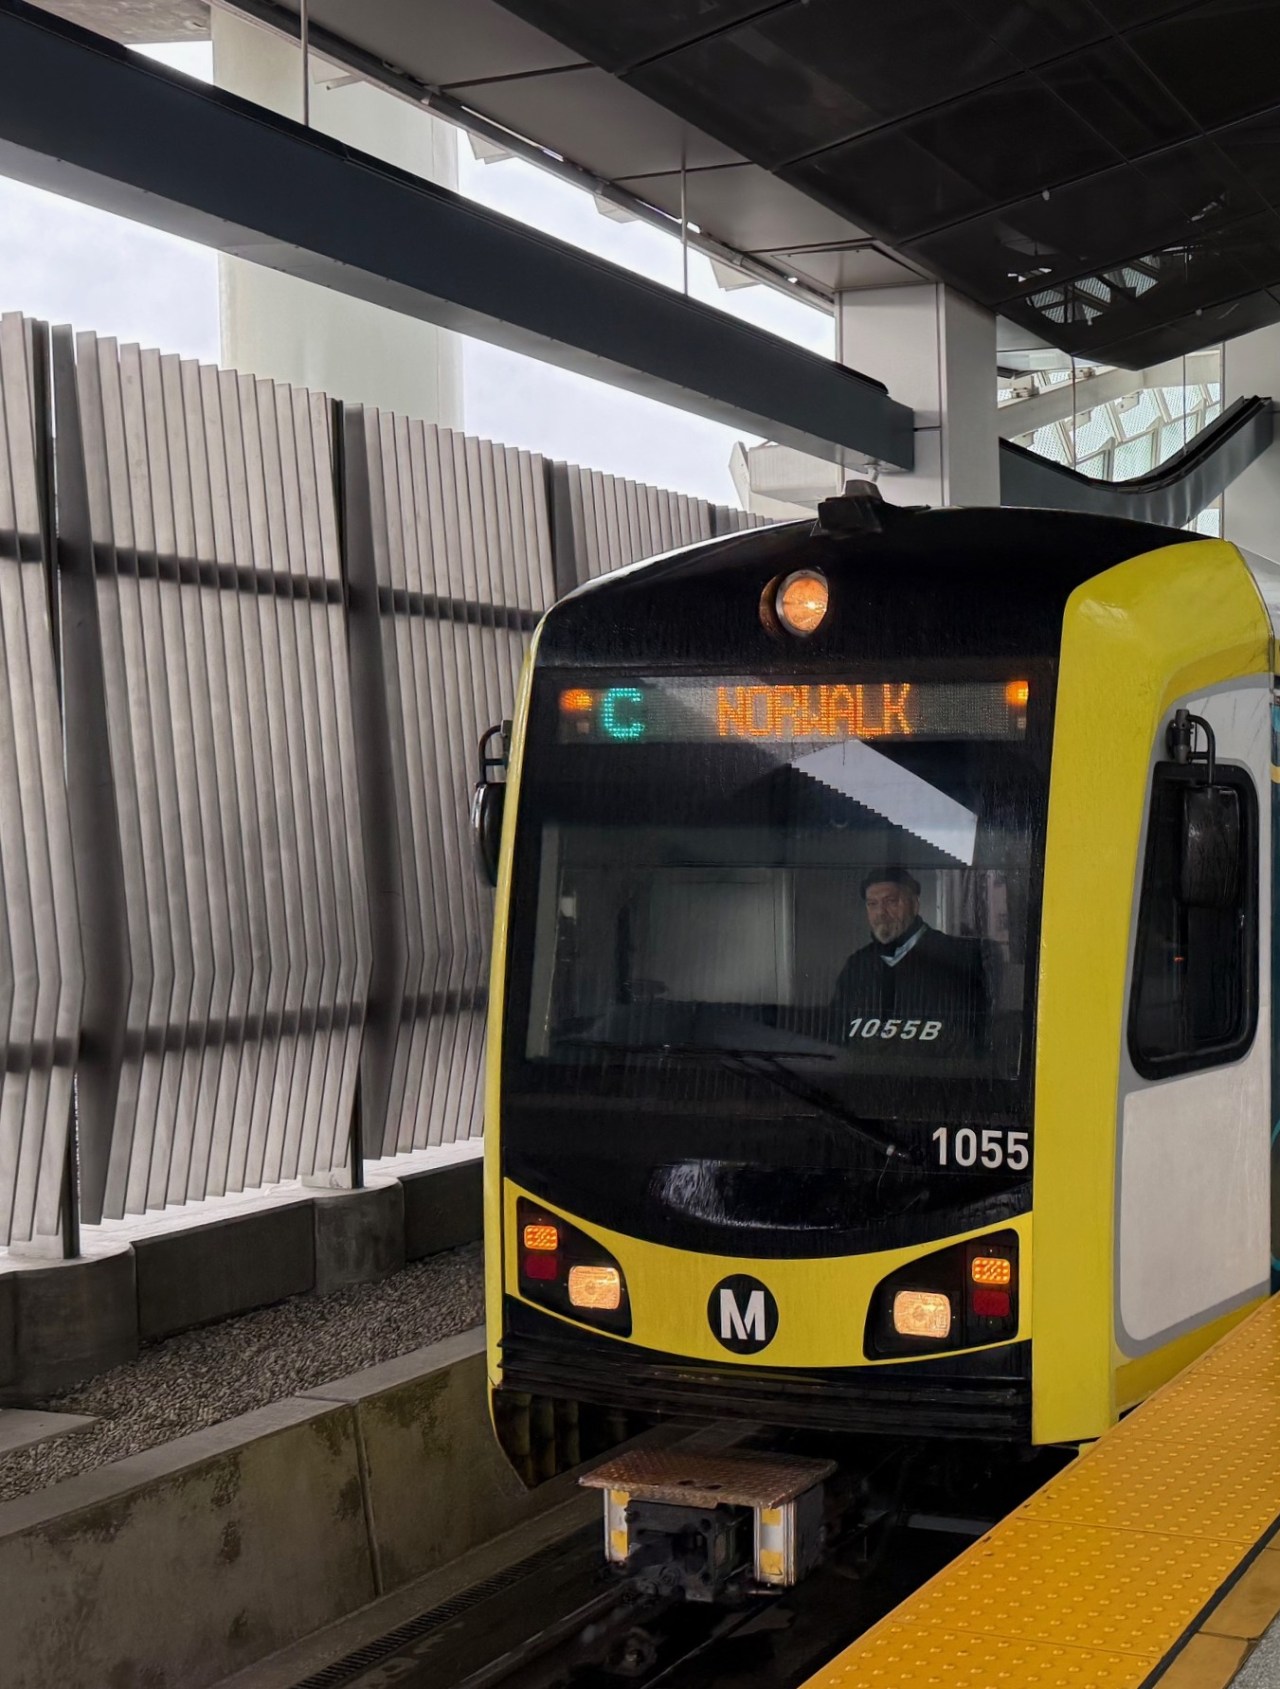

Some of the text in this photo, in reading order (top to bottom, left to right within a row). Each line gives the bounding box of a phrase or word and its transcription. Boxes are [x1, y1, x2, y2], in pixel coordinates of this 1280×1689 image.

[604, 682, 912, 737] C NORWALK
[849, 1018, 942, 1040] 1055B
[932, 1127, 1029, 1171] 1055
[720, 1288, 766, 1341] M
